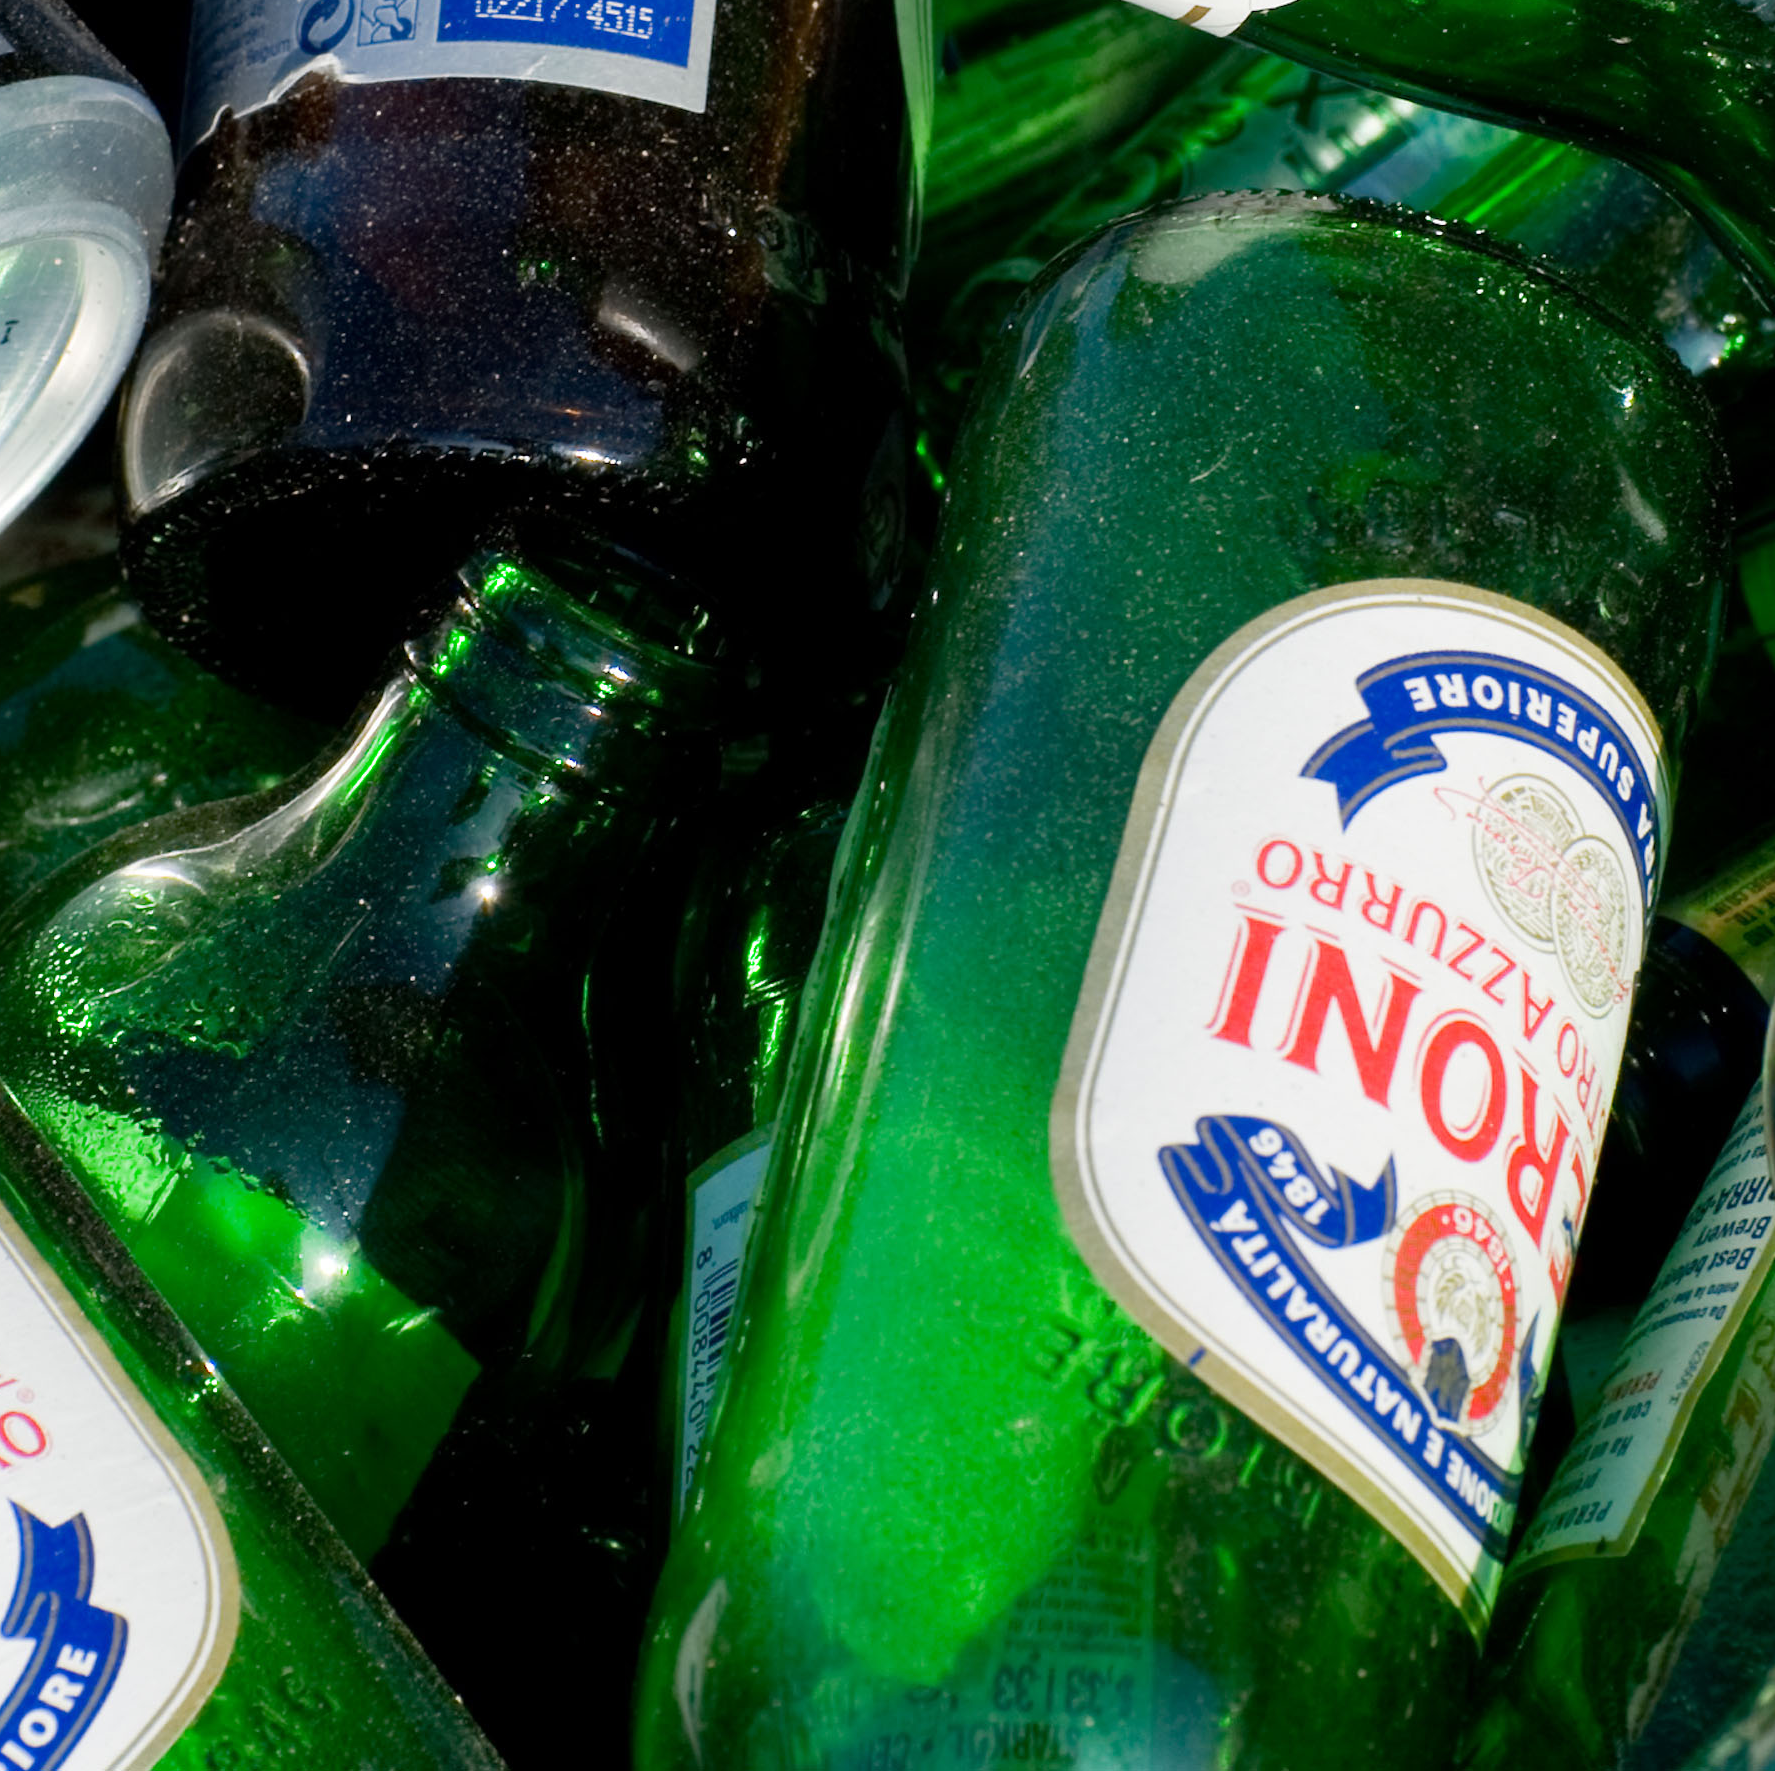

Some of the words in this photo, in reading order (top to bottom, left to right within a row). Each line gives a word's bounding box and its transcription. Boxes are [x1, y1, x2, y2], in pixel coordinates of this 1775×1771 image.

[1402, 672, 1637, 804] SUPERIORE
[1252, 836, 1557, 1041] AZZURRO
[1246, 1127, 1327, 1225] 1846
[1450, 1205, 1508, 1276] 1846
[1723, 1246, 1757, 1271] Best
